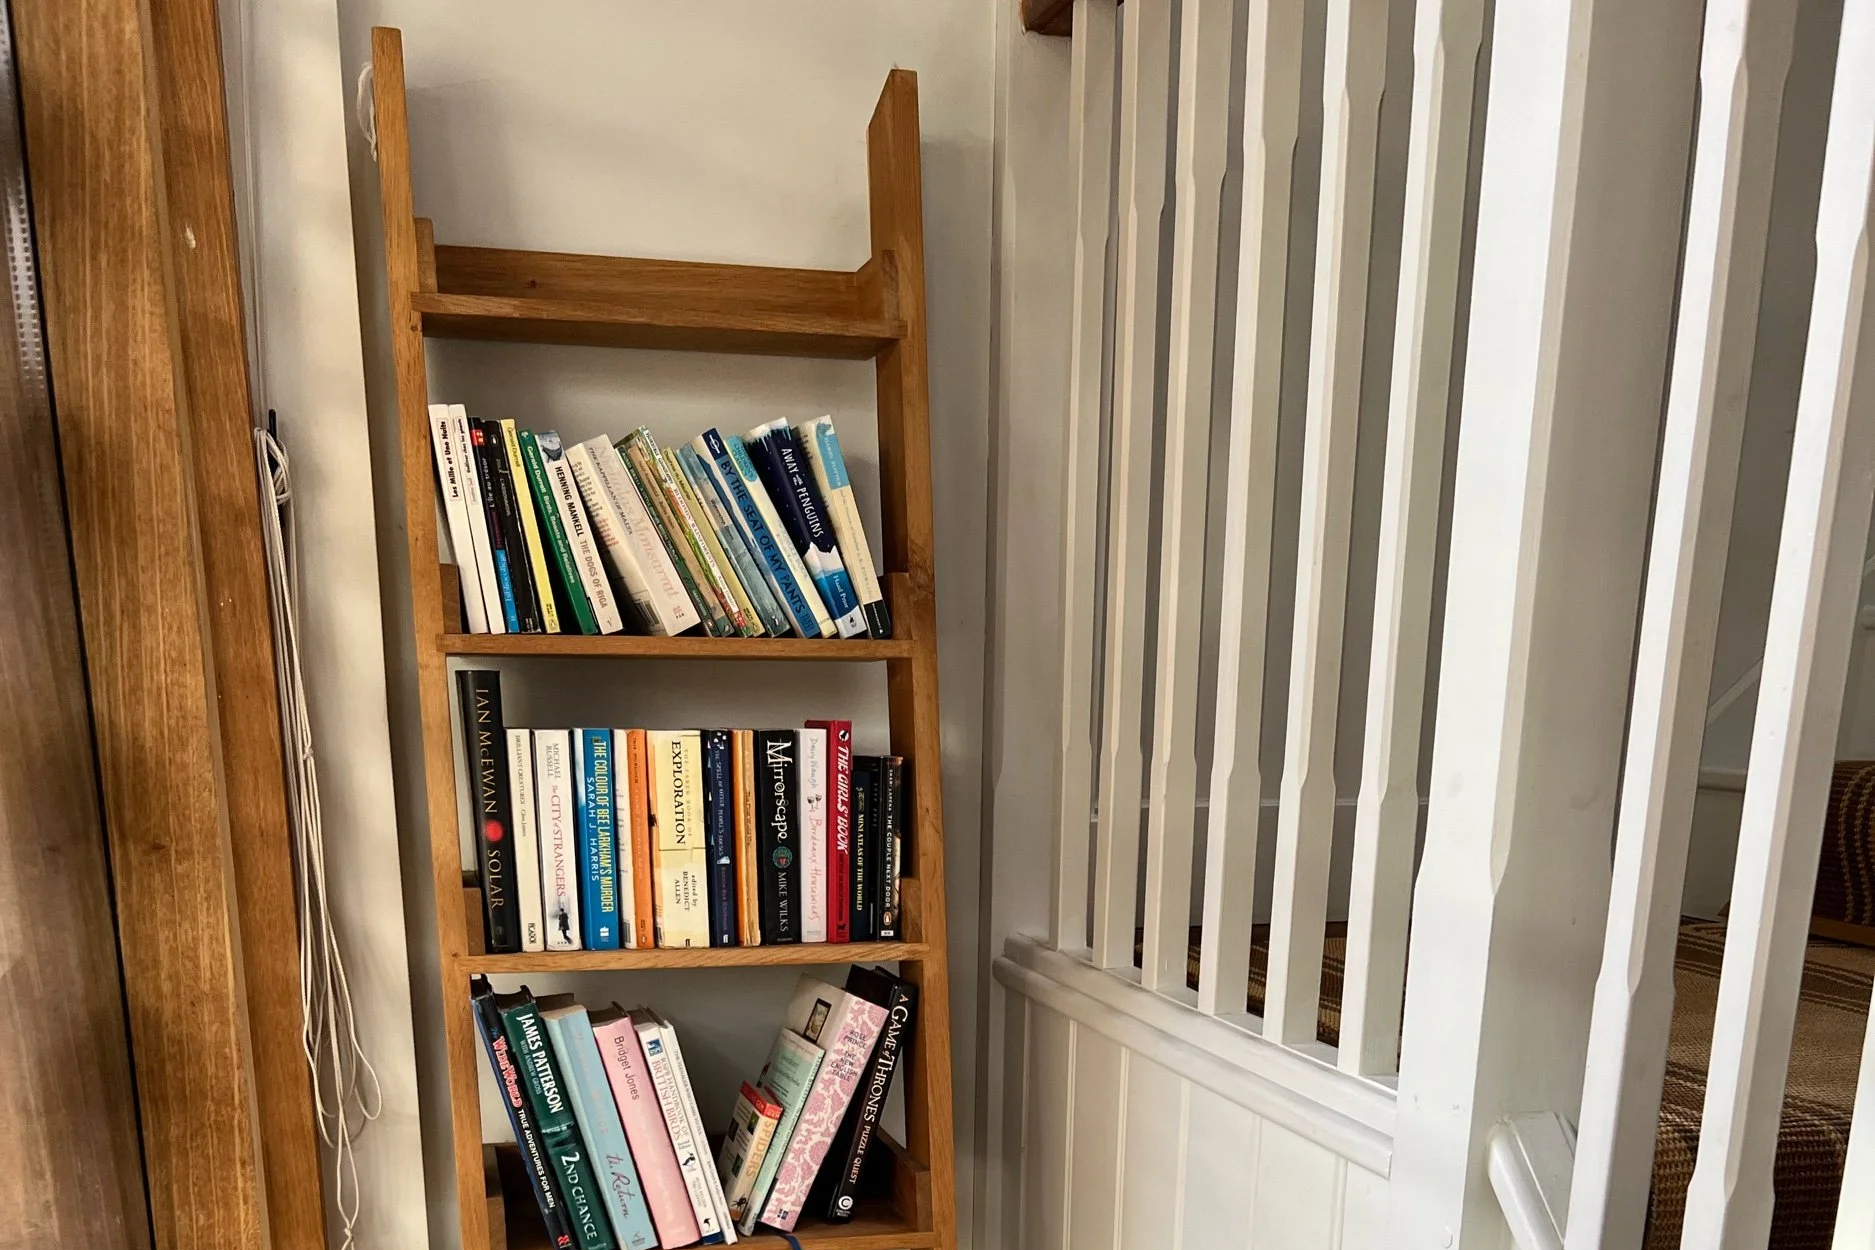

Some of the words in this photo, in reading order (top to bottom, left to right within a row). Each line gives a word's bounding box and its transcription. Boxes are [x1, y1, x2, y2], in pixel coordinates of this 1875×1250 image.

[439, 420, 448, 439] Nuits
[442, 441, 451, 455] Une
[506, 426, 516, 446] Gerald
[511, 447, 521, 467] Durrell
[447, 466, 456, 484] Mille
[486, 481, 492, 490] au
[554, 465, 571, 500] HENNING
[588, 446, 597, 461] THE
[614, 501, 622, 511] OF
[618, 510, 633, 535] MALTA
[781, 445, 799, 474] AWAY
[796, 486, 823, 538] PENGUINS
[526, 445, 538, 469] Gerald
[533, 469, 546, 493] Durrell
[549, 515, 561, 539] Beasts
[556, 538, 565, 552] and
[561, 552, 576, 583] Relatives
[566, 501, 583, 536] MANKELL
[579, 539, 589, 555] THE
[720, 460, 734, 477] BY
[729, 478, 747, 502] THE
[742, 504, 764, 534] SEAT
[758, 534, 774, 554] OF
[768, 552, 784, 573] MY
[779, 574, 805, 613] PANTS
[584, 555, 597, 577] DOGS
[592, 578, 601, 589] OF
[596, 589, 607, 608] RIGA
[832, 574, 843, 591] Hazel
[839, 591, 850, 608] Prior
[476, 688, 489, 723] IAN
[514, 735, 522, 768] BRILLIANT
[545, 745, 553, 777] RUSSELL
[551, 742, 560, 779] MICHAEL
[594, 740, 606, 757] THE
[837, 745, 848, 773] THE
[479, 728, 495, 813] McEWAN
[517, 769, 525, 804] CREATURES
[594, 759, 608, 794] COLOUR
[587, 776, 595, 816] SARAH
[596, 795, 608, 806] OF
[671, 740, 685, 844] EXPLORATION
[765, 738, 792, 843] Mirrorscape
[837, 774, 848, 816] GIRLS'
[550, 794, 561, 823] CITY
[597, 808, 609, 823] BEE
[589, 823, 596, 831] J.
[686, 827, 691, 837] OF
[809, 816, 820, 864] Bordeaux
[837, 816, 848, 854] BOOK
[552, 828, 566, 896] STRANGERS
[590, 838, 599, 880] HARRIS
[598, 826, 611, 875] LARKHAM'S
[857, 856, 862, 865] OF
[488, 848, 503, 908] SOLAR
[600, 876, 613, 912] MURDER
[778, 871, 787, 896] MIKE
[809, 867, 820, 920] Housewives
[690, 898, 697, 906] by
[779, 899, 788, 931] WILKS
[527, 922, 536, 943] PICADOR
[899, 994, 908, 1003] A
[843, 1034, 867, 1049] PRINCE
[848, 1029, 868, 1041] ROSE
[883, 1004, 909, 1050] GAME
[516, 1012, 543, 1050] JAMES
[531, 1050, 563, 1113] PATTERSON
[519, 1039, 529, 1054] WITH
[839, 1057, 854, 1067] NEW
[843, 1050, 856, 1060] THE
[883, 1050, 893, 1059] of
[523, 1053, 536, 1077] ANDREW
[612, 1035, 632, 1070] Bridget
[624, 1071, 641, 1100] Jones
[830, 1060, 858, 1077] ENGLISH
[831, 1068, 851, 1082] TABLE
[501, 1065, 525, 1108] WORLD
[531, 1077, 542, 1094] GROSS
[651, 1060, 672, 1105] BRITISH
[666, 1107, 682, 1140] BIRDS
[660, 1057, 670, 1076] RSPB
[666, 1077, 685, 1124] HANDBOOK
[681, 1125, 688, 1136] OF
[861, 1052, 895, 1122] THRONES
[516, 1108, 529, 1128] TRUE
[523, 1128, 544, 1176] ADVENTURES
[745, 1120, 774, 1178] SPIDERS
[856, 1125, 870, 1155] PUZZLE
[539, 1175, 550, 1191] FOR
[848, 1156, 862, 1183] QUEST
[544, 1191, 555, 1208] MEN
[560, 1150, 580, 1185] 2ND
[570, 1185, 598, 1240] CHANCE
[608, 1167, 640, 1220] Return
